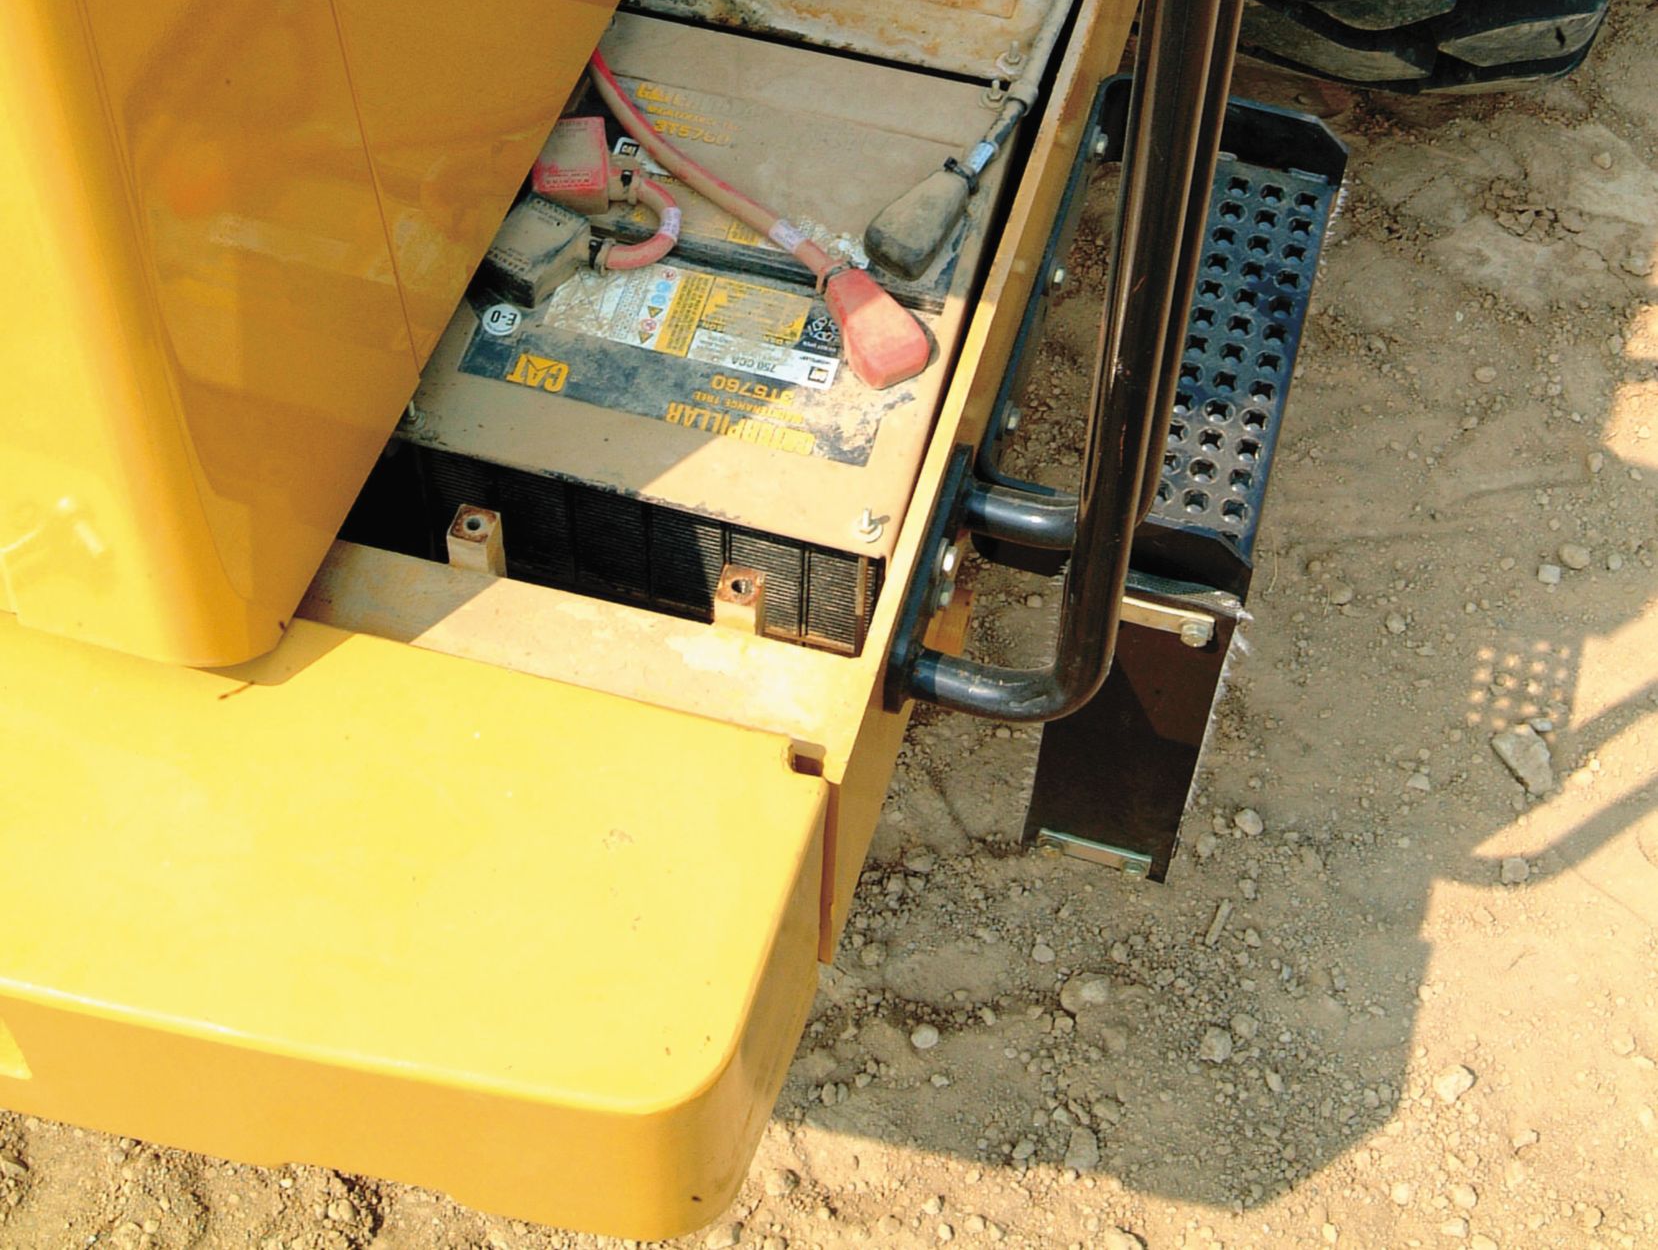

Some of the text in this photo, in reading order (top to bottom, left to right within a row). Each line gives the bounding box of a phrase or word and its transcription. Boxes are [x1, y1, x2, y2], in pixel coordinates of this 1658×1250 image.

[654, 119, 731, 146] 3T5760
[490, 310, 517, 326] E-0
[505, 353, 569, 392] CAT
[732, 355, 755, 368] CCA
[710, 372, 796, 406] 3T5760
